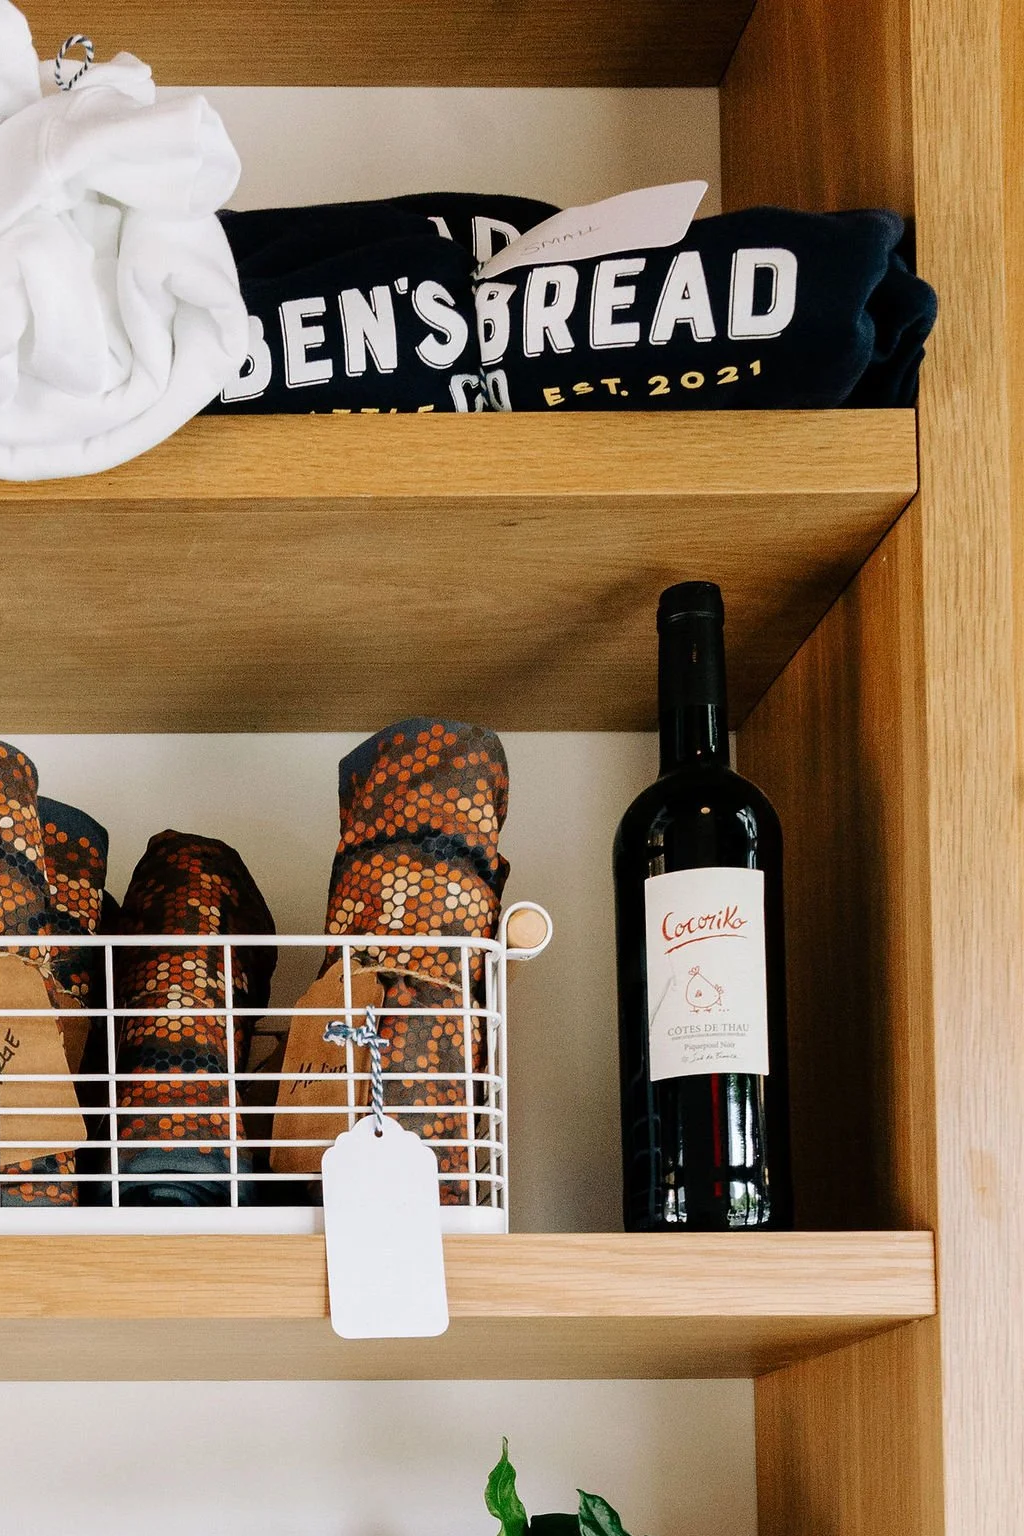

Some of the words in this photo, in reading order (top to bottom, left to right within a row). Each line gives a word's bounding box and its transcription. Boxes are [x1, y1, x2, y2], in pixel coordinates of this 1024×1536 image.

[221, 276, 469, 403] BEN'S
[476, 247, 798, 367] BREAD
[542, 378, 629, 407] EST.
[647, 360, 762, 396] 2021
[704, 1023, 718, 1032] DE
[722, 1023, 750, 1032] THAU
